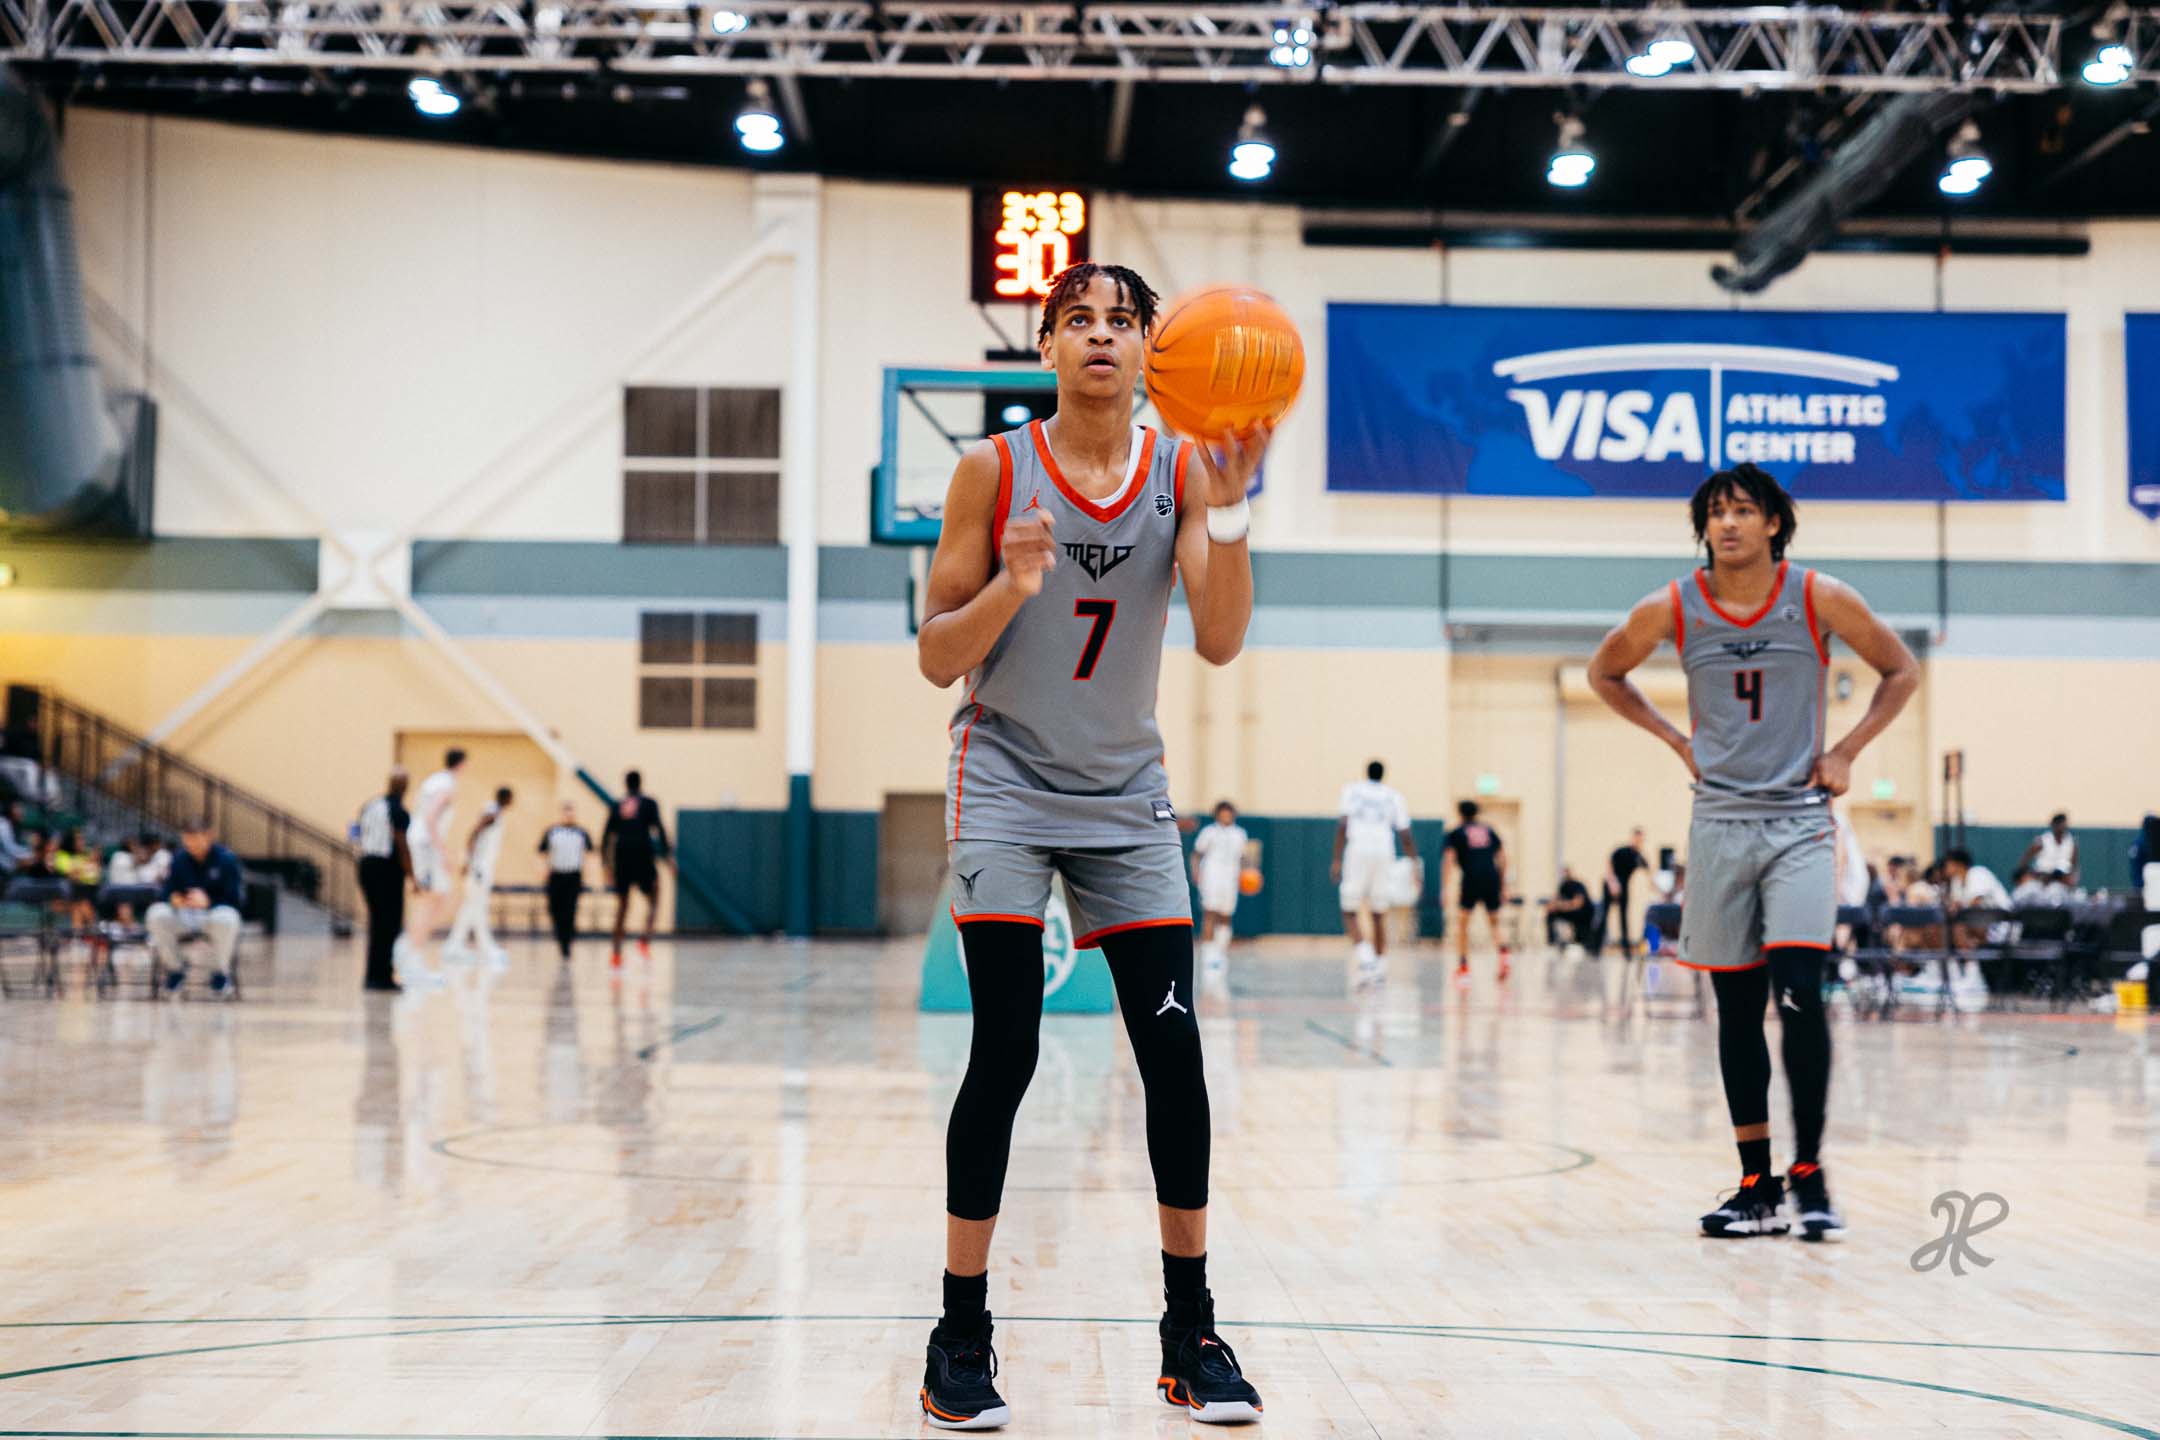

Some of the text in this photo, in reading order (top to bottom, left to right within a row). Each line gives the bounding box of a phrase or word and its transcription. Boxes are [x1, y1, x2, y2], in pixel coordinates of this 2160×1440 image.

[995, 229, 1069, 295] 30
[1507, 388, 1704, 463] VISA
[1726, 394, 1887, 426] ATHLETIC
[1726, 431, 1856, 464] CENTER
[1072, 598, 1117, 681] 7
[1734, 669, 1763, 722] 4
